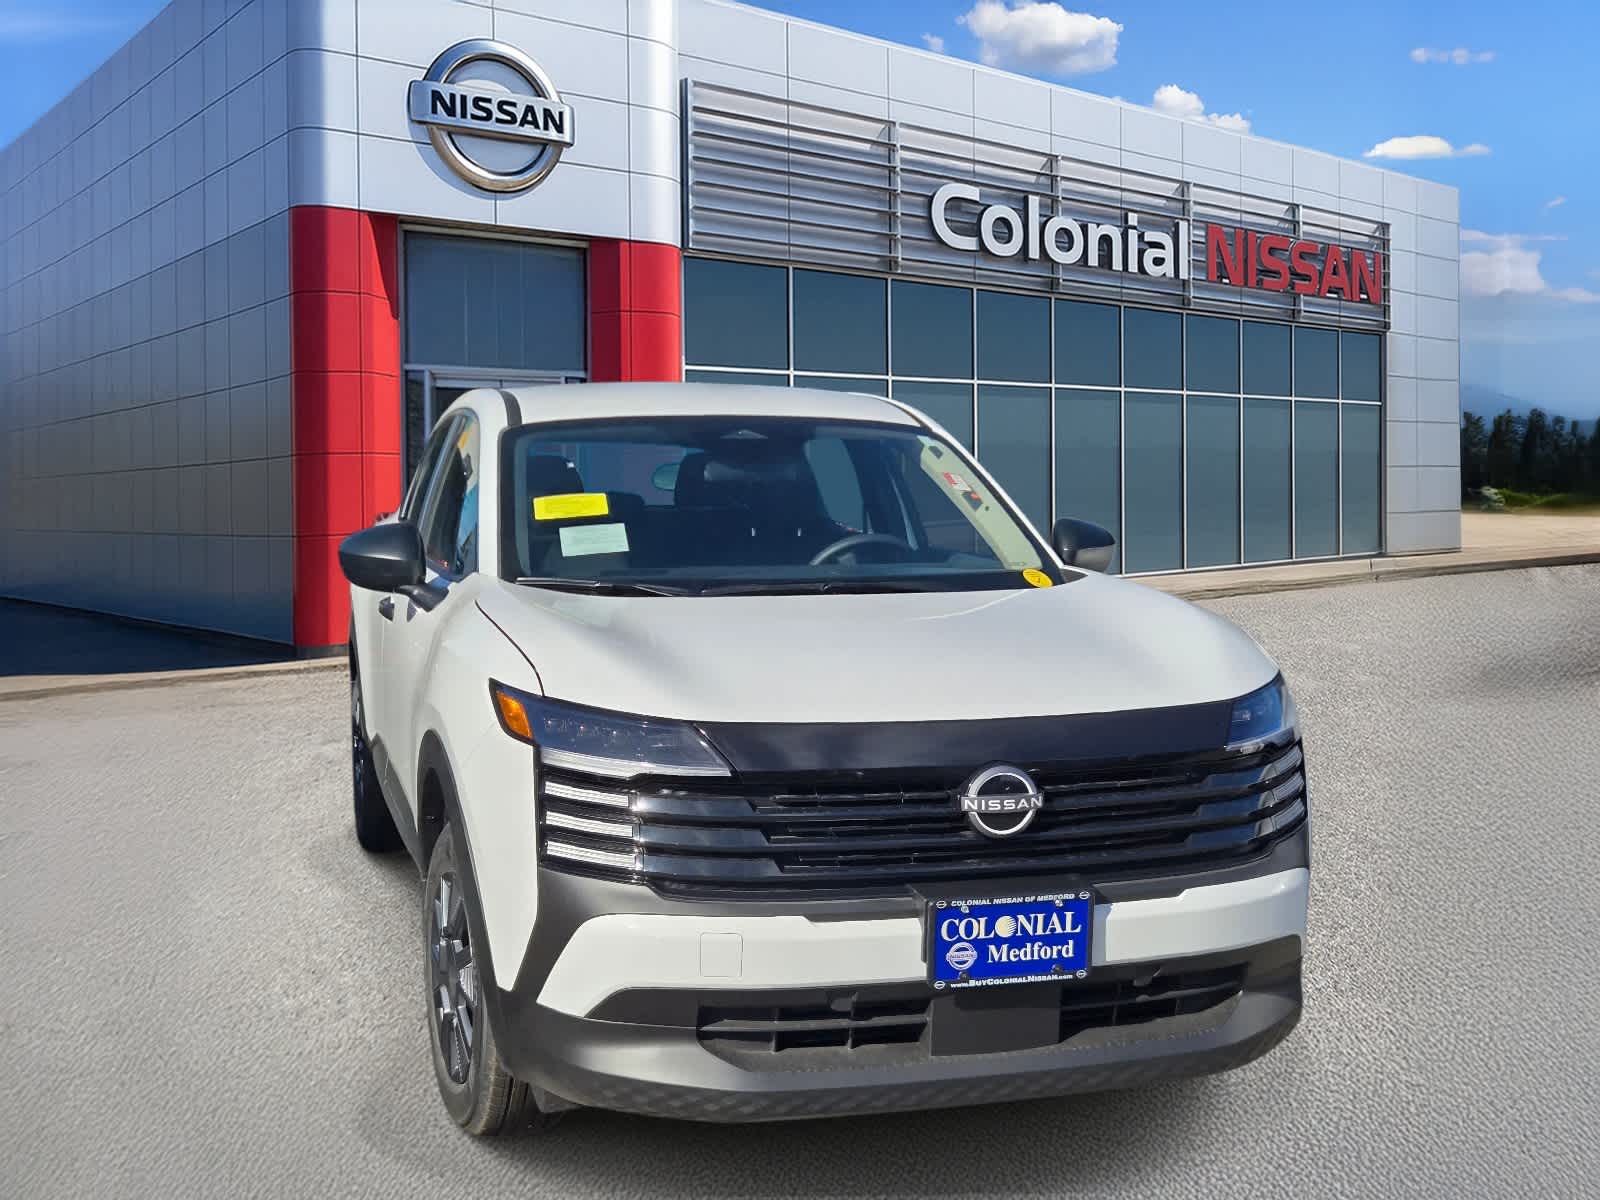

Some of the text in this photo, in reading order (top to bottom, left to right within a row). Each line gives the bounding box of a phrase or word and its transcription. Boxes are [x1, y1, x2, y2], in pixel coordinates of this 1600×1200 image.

[430, 89, 564, 134] NISSAN
[931, 182, 1383, 305] Colonial NISSAN
[964, 795, 1043, 811] NISSAN
[950, 893, 1075, 907] COLONIAL NISSAN OF MEDFORD
[940, 911, 1082, 942] COLONIAL
[987, 939, 1075, 963] Medford
